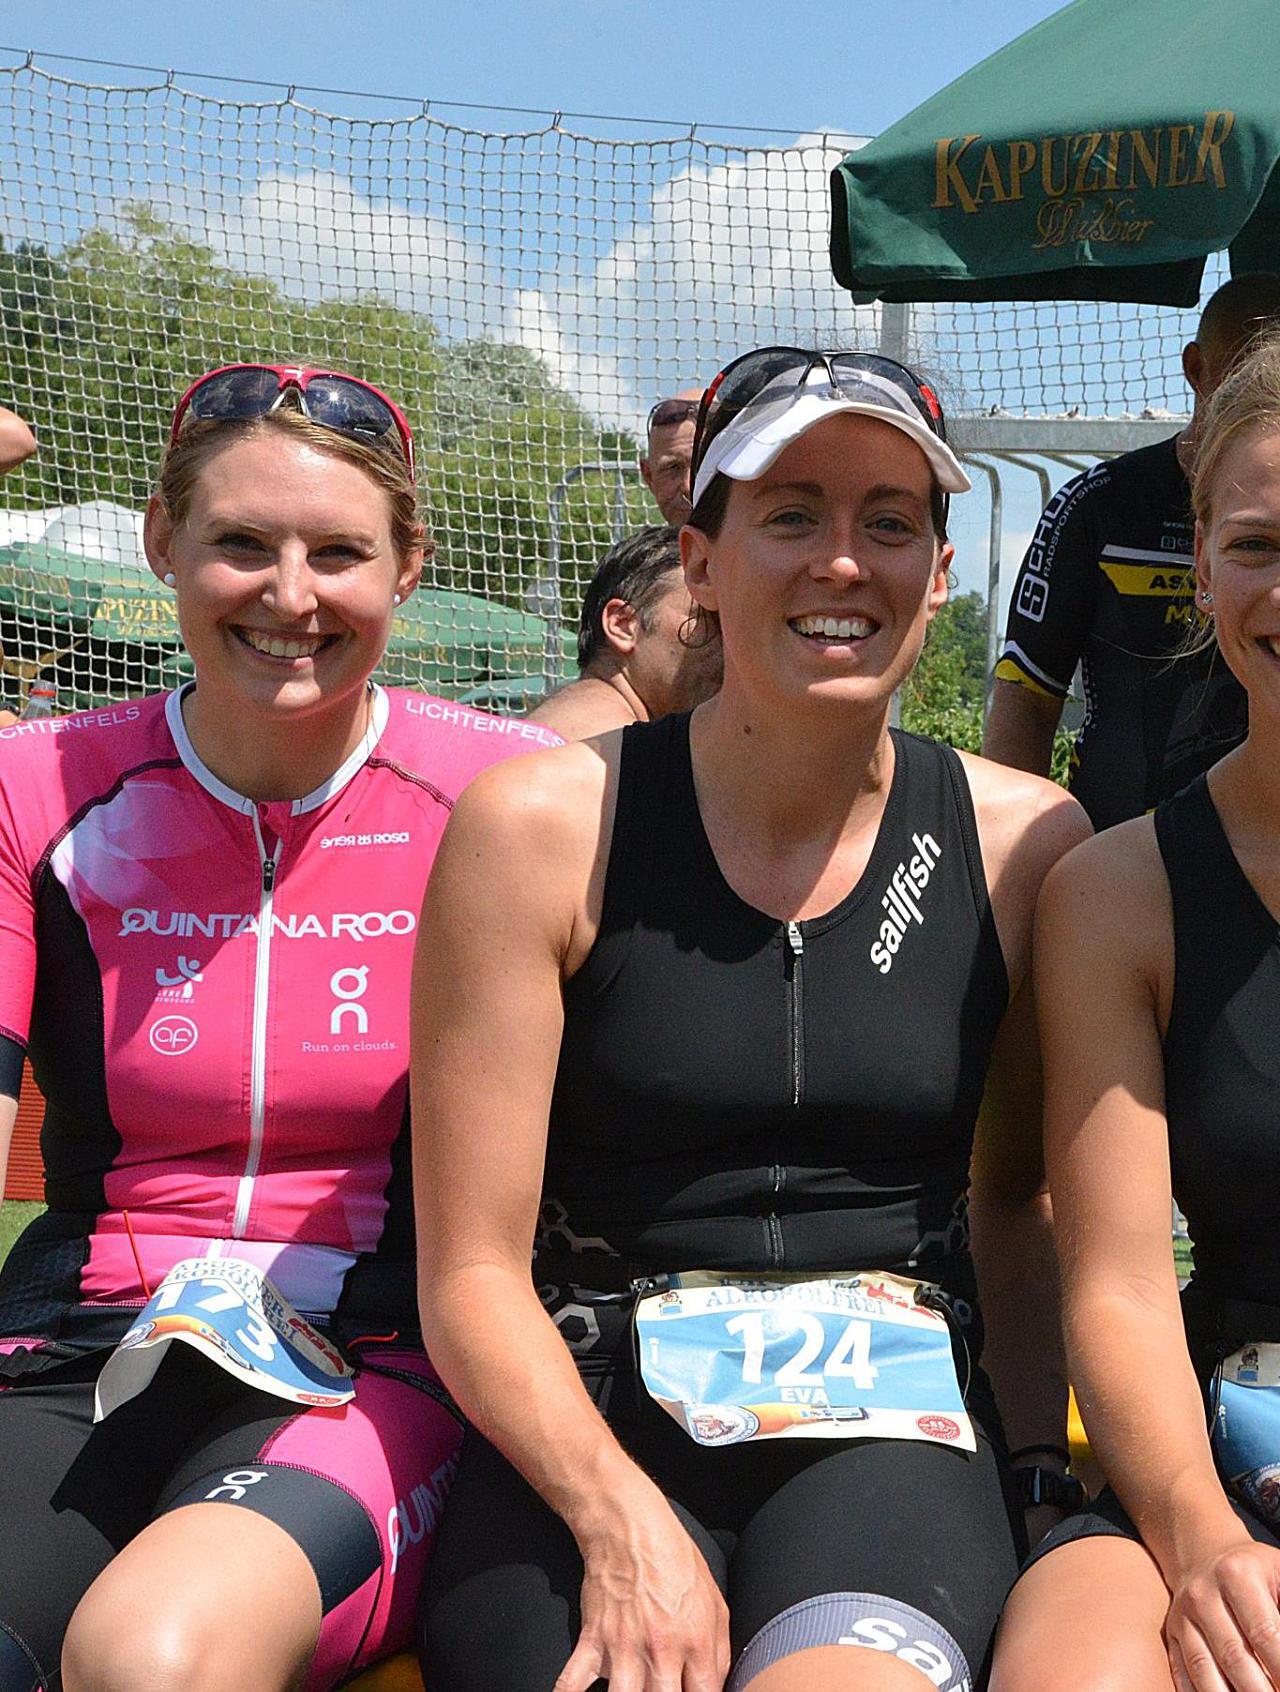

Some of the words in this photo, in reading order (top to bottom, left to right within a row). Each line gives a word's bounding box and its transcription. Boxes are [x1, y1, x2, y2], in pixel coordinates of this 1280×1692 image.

[930, 110, 1235, 214] KAPUZINER
[0, 706, 141, 741] CHTENFELS
[405, 698, 568, 748] LICHTENFELS
[119, 907, 329, 938] QUINTANA
[332, 910, 417, 942] ROO
[870, 831, 943, 975] sailfish
[302, 1041, 328, 1052] Run
[333, 1043, 349, 1052] on
[155, 1280, 279, 1362] 173
[724, 1311, 880, 1390] 124
[780, 1385, 830, 1404] EVA
[838, 1617, 971, 1692] sa
